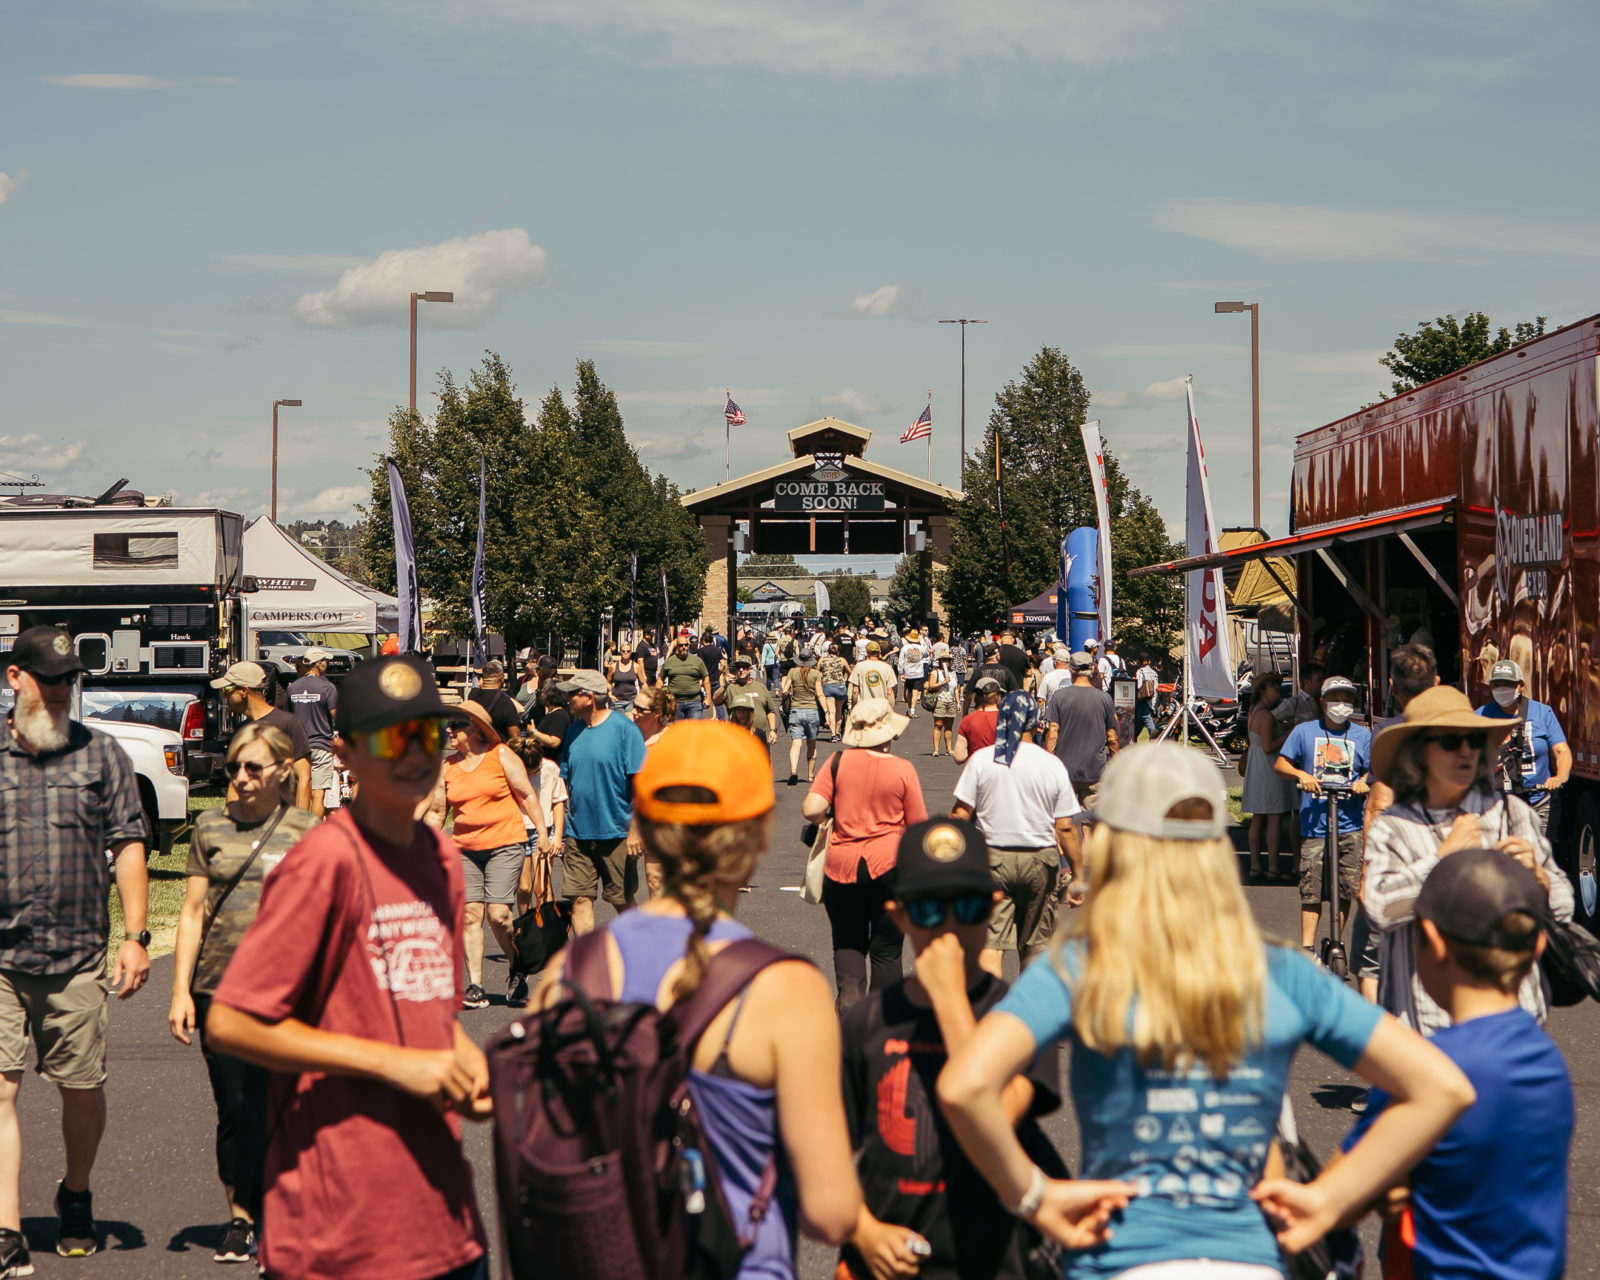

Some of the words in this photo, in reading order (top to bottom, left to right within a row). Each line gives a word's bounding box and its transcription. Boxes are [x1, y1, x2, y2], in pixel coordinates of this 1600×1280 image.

[775, 483, 828, 496] COME
[834, 483, 884, 496] BACK
[802, 496, 857, 509] SOON!
[1511, 513, 1563, 564] OVERLAND
[1527, 570, 1548, 597] EXPO
[251, 611, 343, 621] CAMPERS.COM
